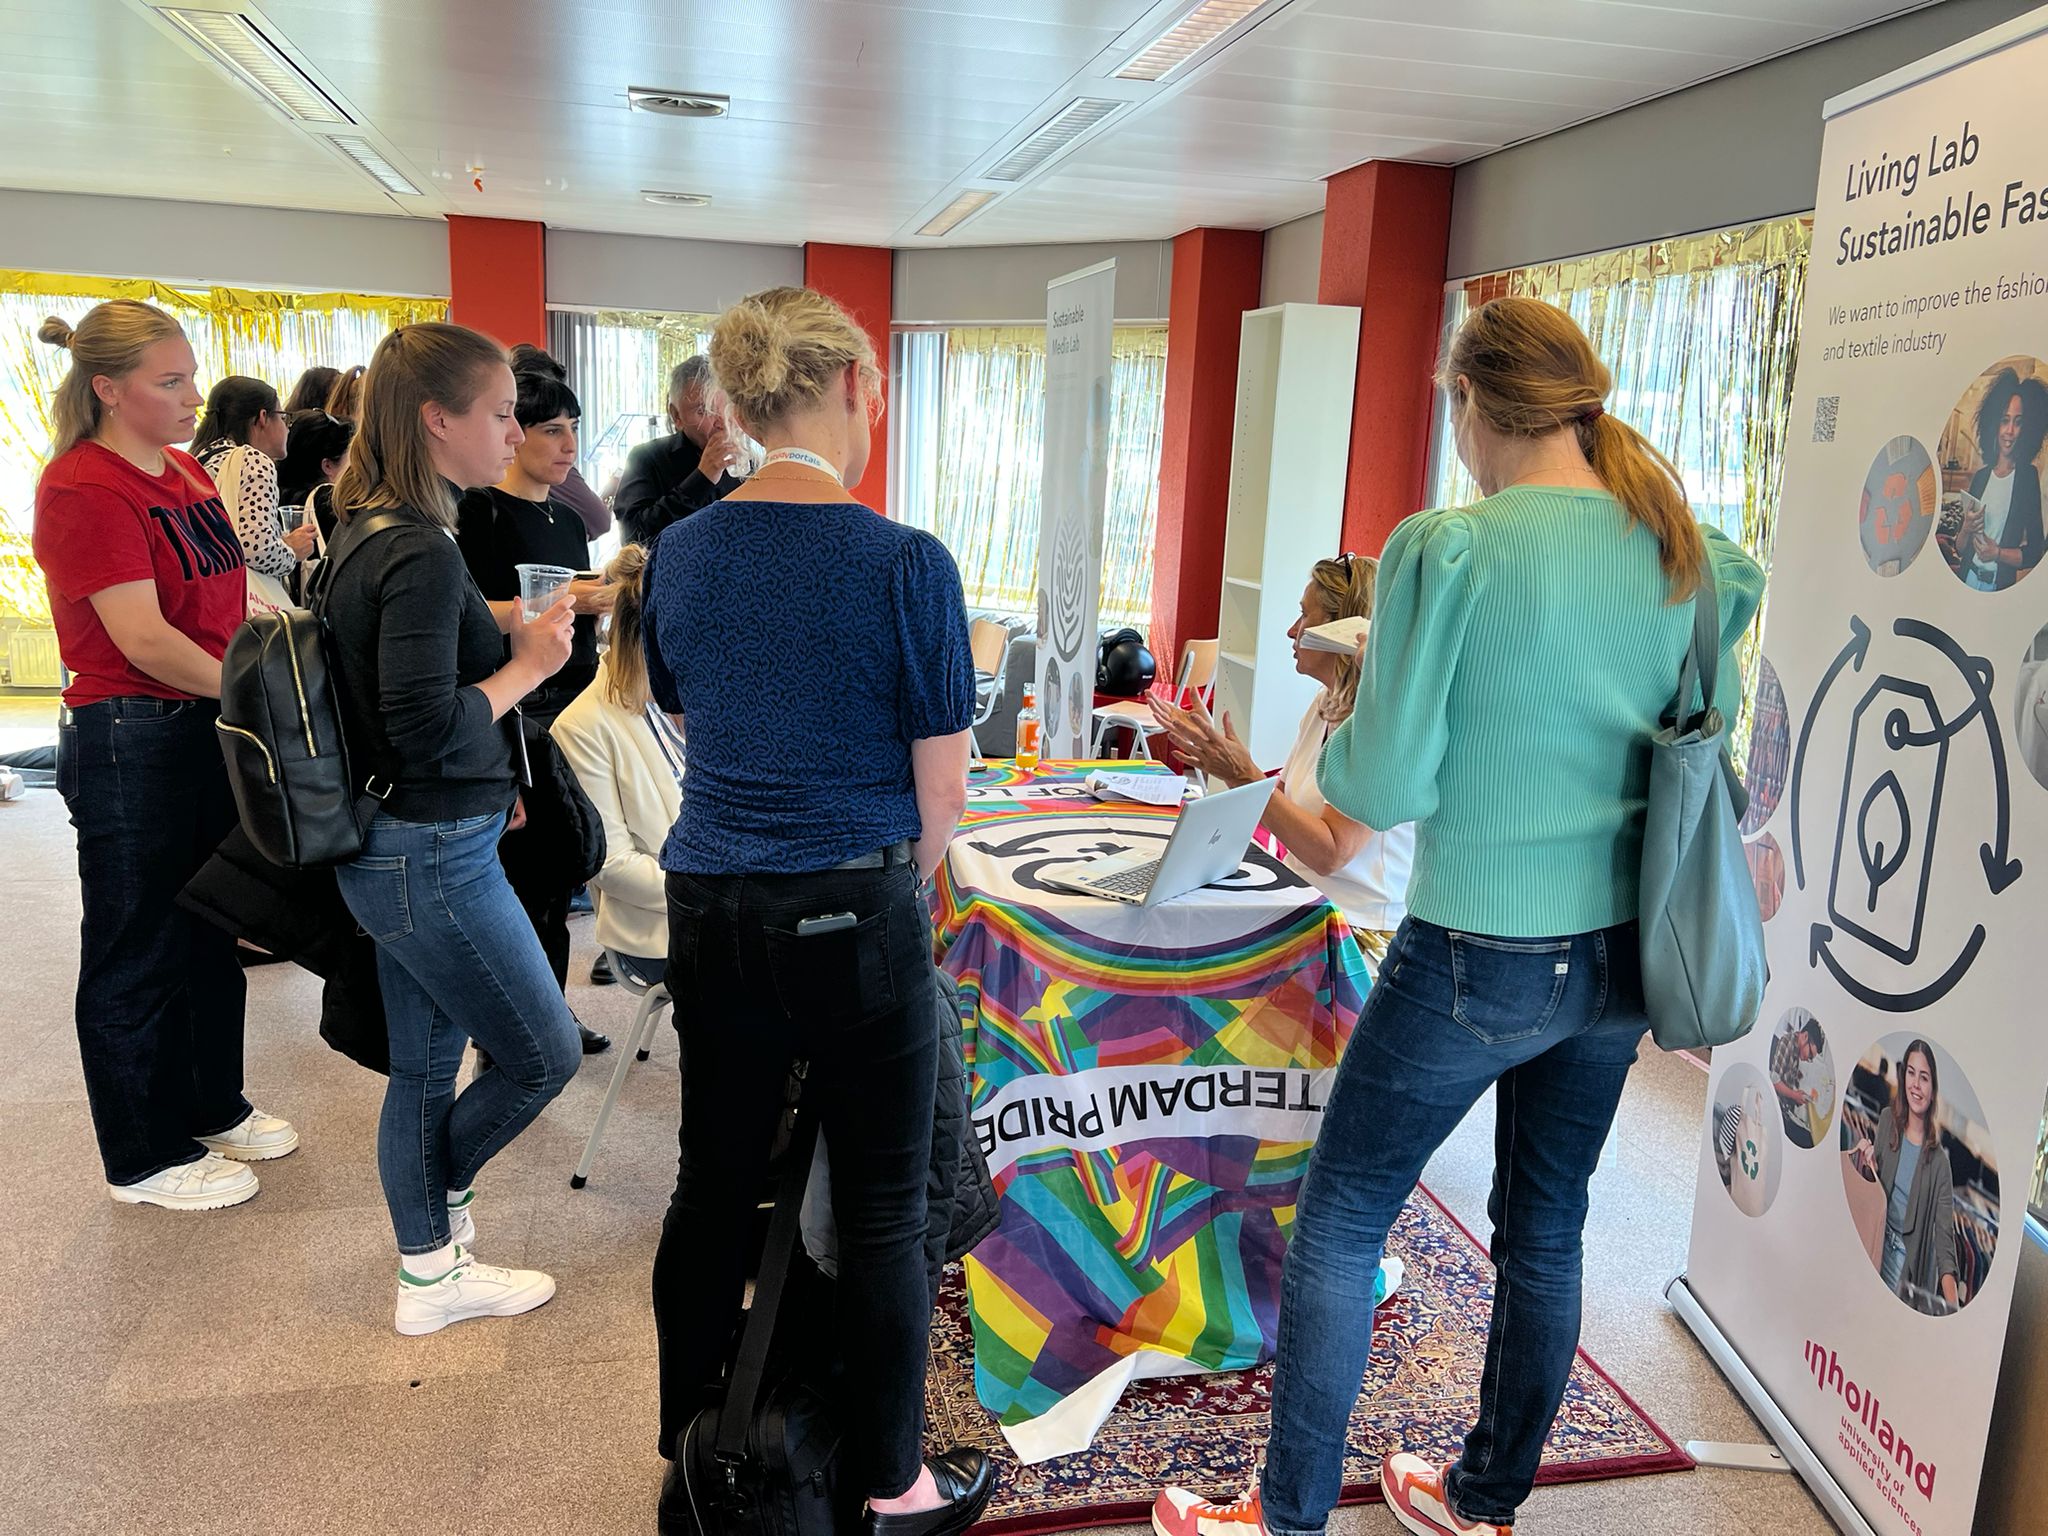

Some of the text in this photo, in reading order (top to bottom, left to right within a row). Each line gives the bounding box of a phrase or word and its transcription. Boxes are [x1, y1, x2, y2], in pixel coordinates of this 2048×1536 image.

[1845, 121, 1980, 202] Living Lab
[1836, 181, 2048, 266] Sustainable Fas
[1053, 304, 1084, 328] Sustainable
[1828, 272, 2048, 326] We want to improve the fashio
[1070, 332, 1080, 352] Lab
[1823, 329, 1947, 361] and textile industry
[1028, 787, 1086, 796] OF
[972, 1070, 1326, 1158] TERDAM PRIDE
[1804, 1339, 1936, 1503] inholland
[1841, 1415, 1905, 1497] university of
[1838, 1431, 1921, 1536] applied sciences
